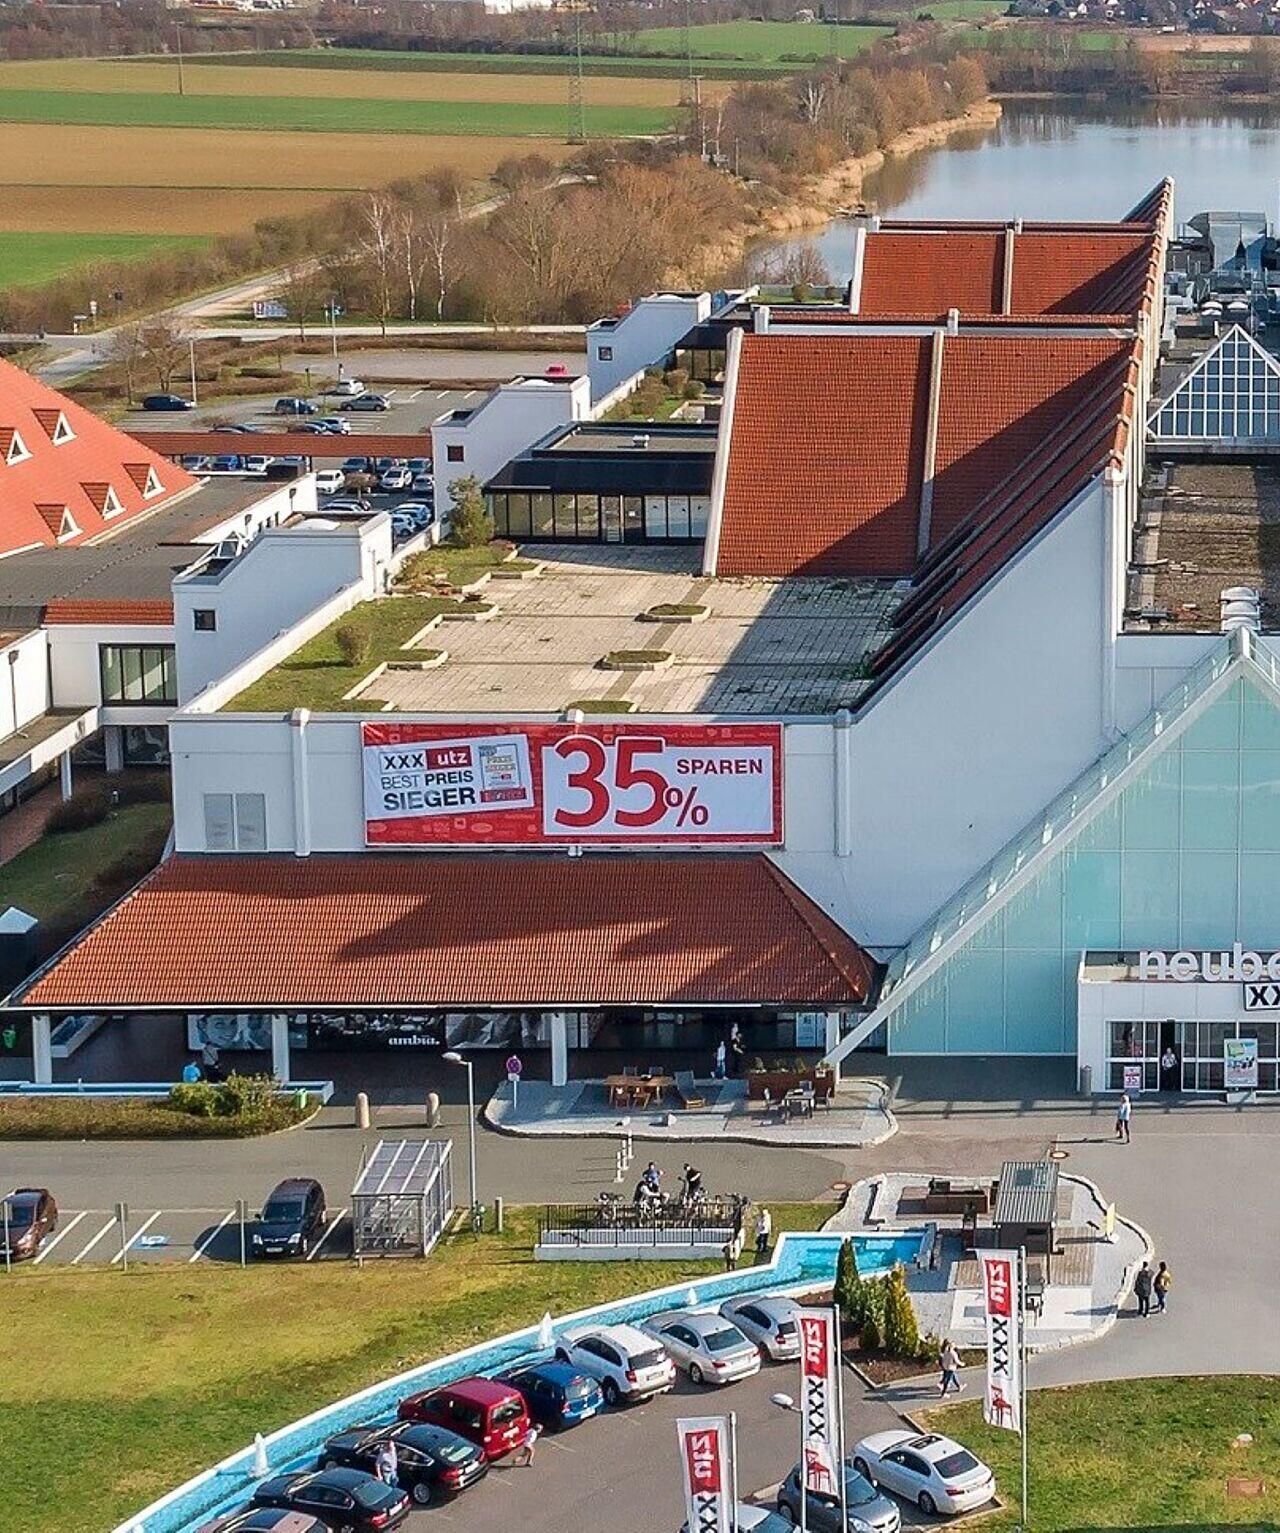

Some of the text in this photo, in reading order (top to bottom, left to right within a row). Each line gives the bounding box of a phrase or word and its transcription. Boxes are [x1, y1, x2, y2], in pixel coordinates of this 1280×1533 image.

[676, 758, 763, 775] SPAREN
[381, 775, 420, 790] BEST
[424, 770, 474, 786] PREIS
[383, 786, 477, 811] SIEGER
